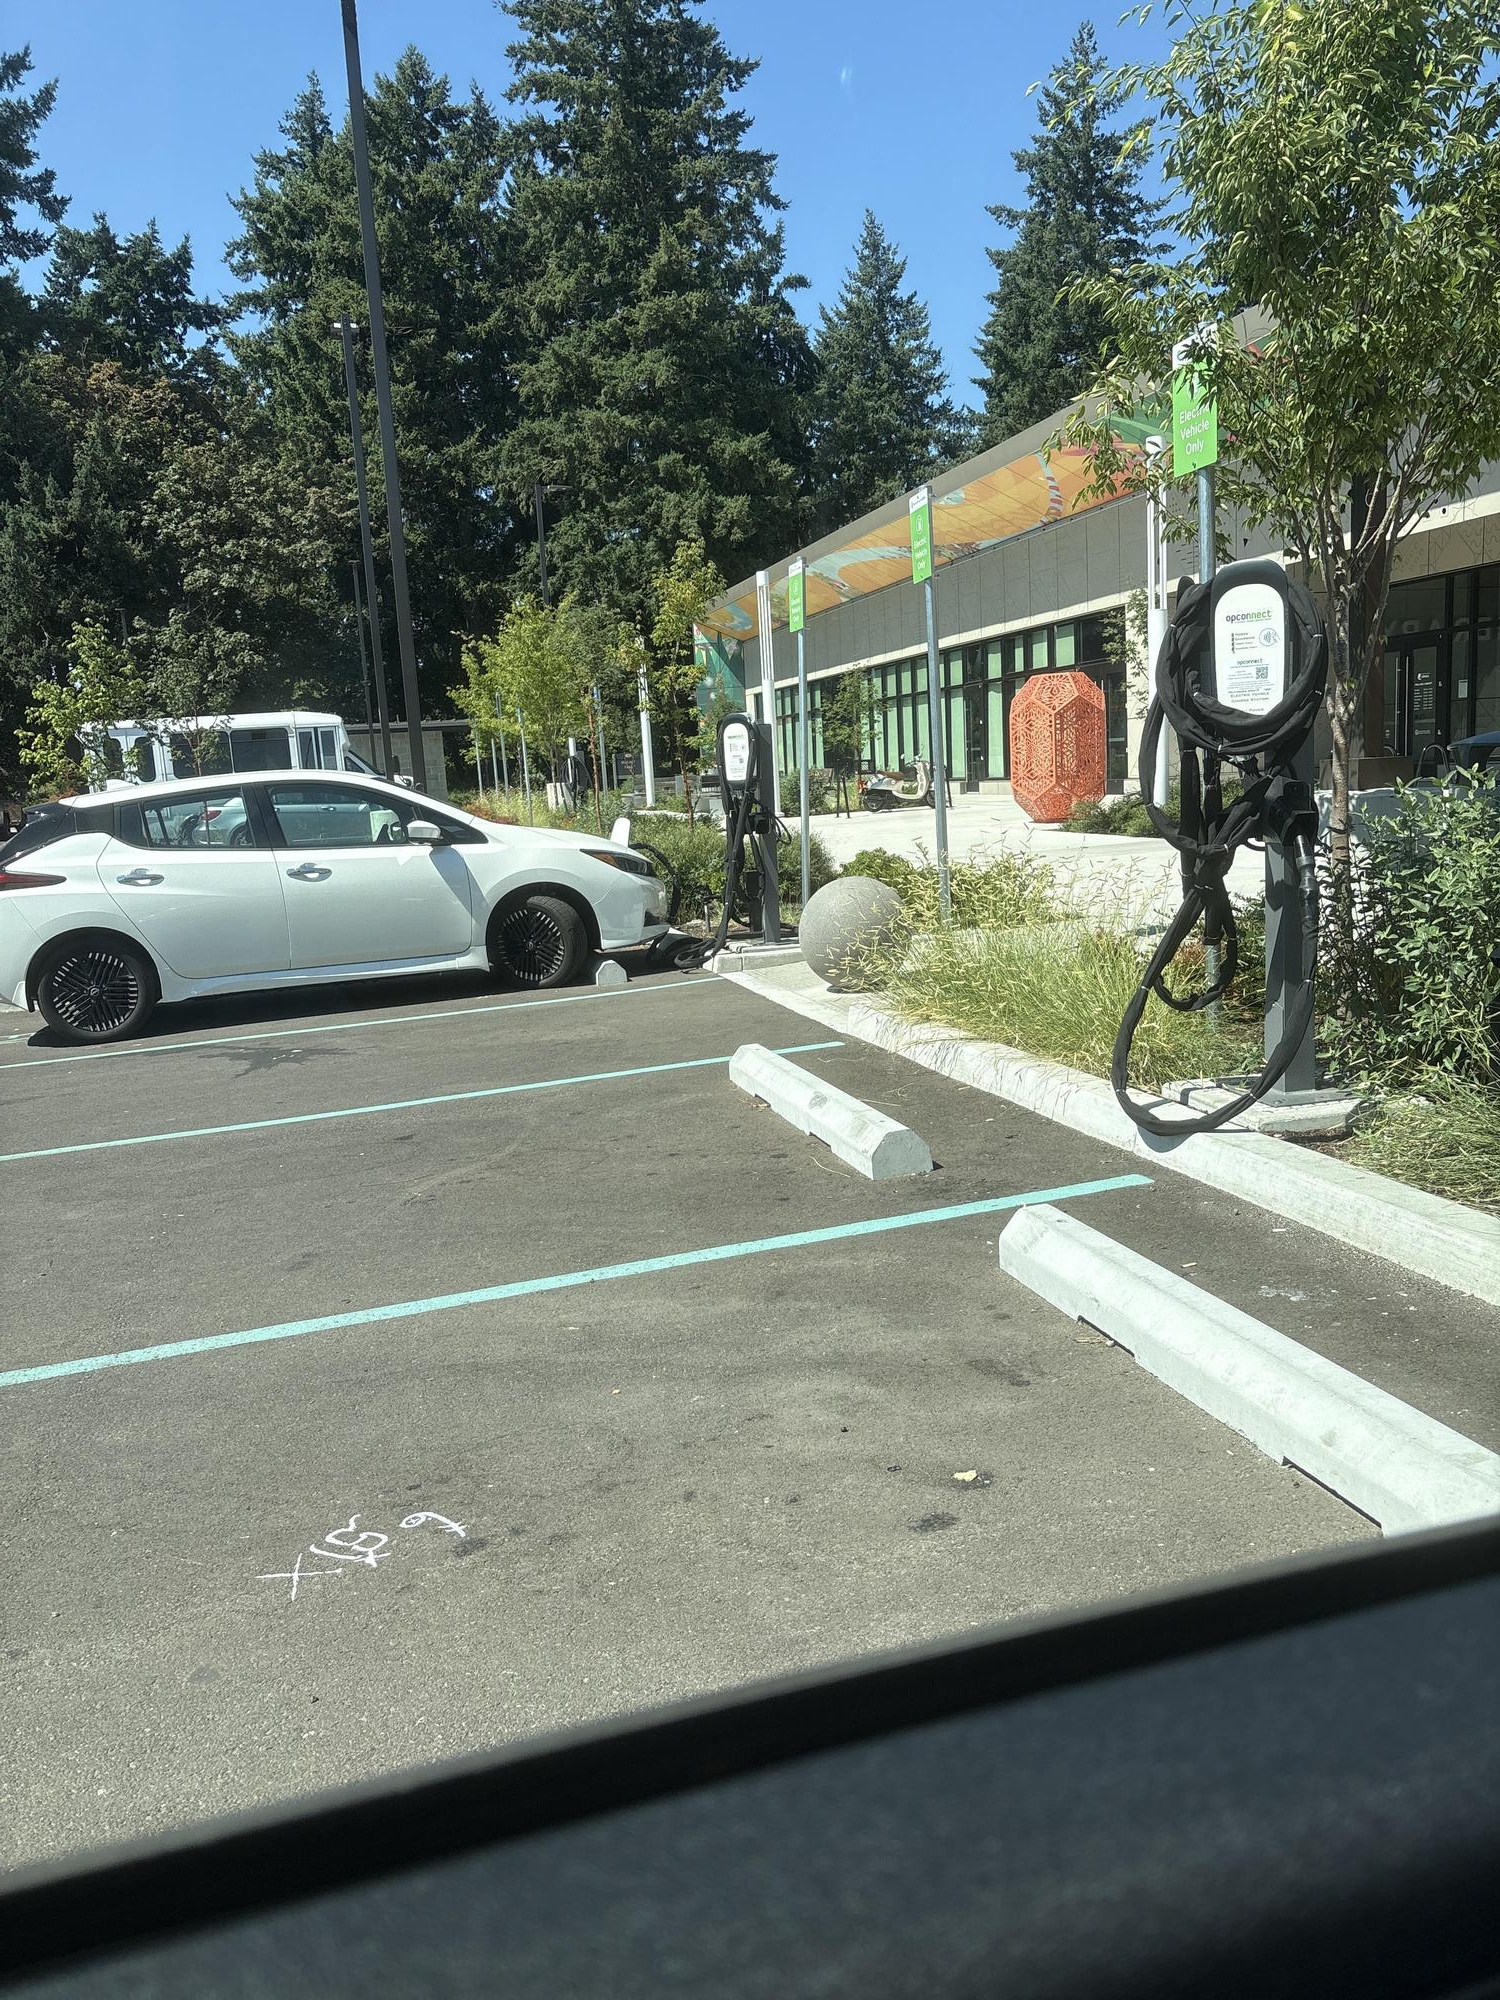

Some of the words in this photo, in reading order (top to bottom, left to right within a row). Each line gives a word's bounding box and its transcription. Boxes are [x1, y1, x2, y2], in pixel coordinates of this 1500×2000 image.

[1180, 419, 1210, 440] Vehicle
[1185, 438, 1205, 455] Only
[1225, 609, 1272, 624] opconnect
